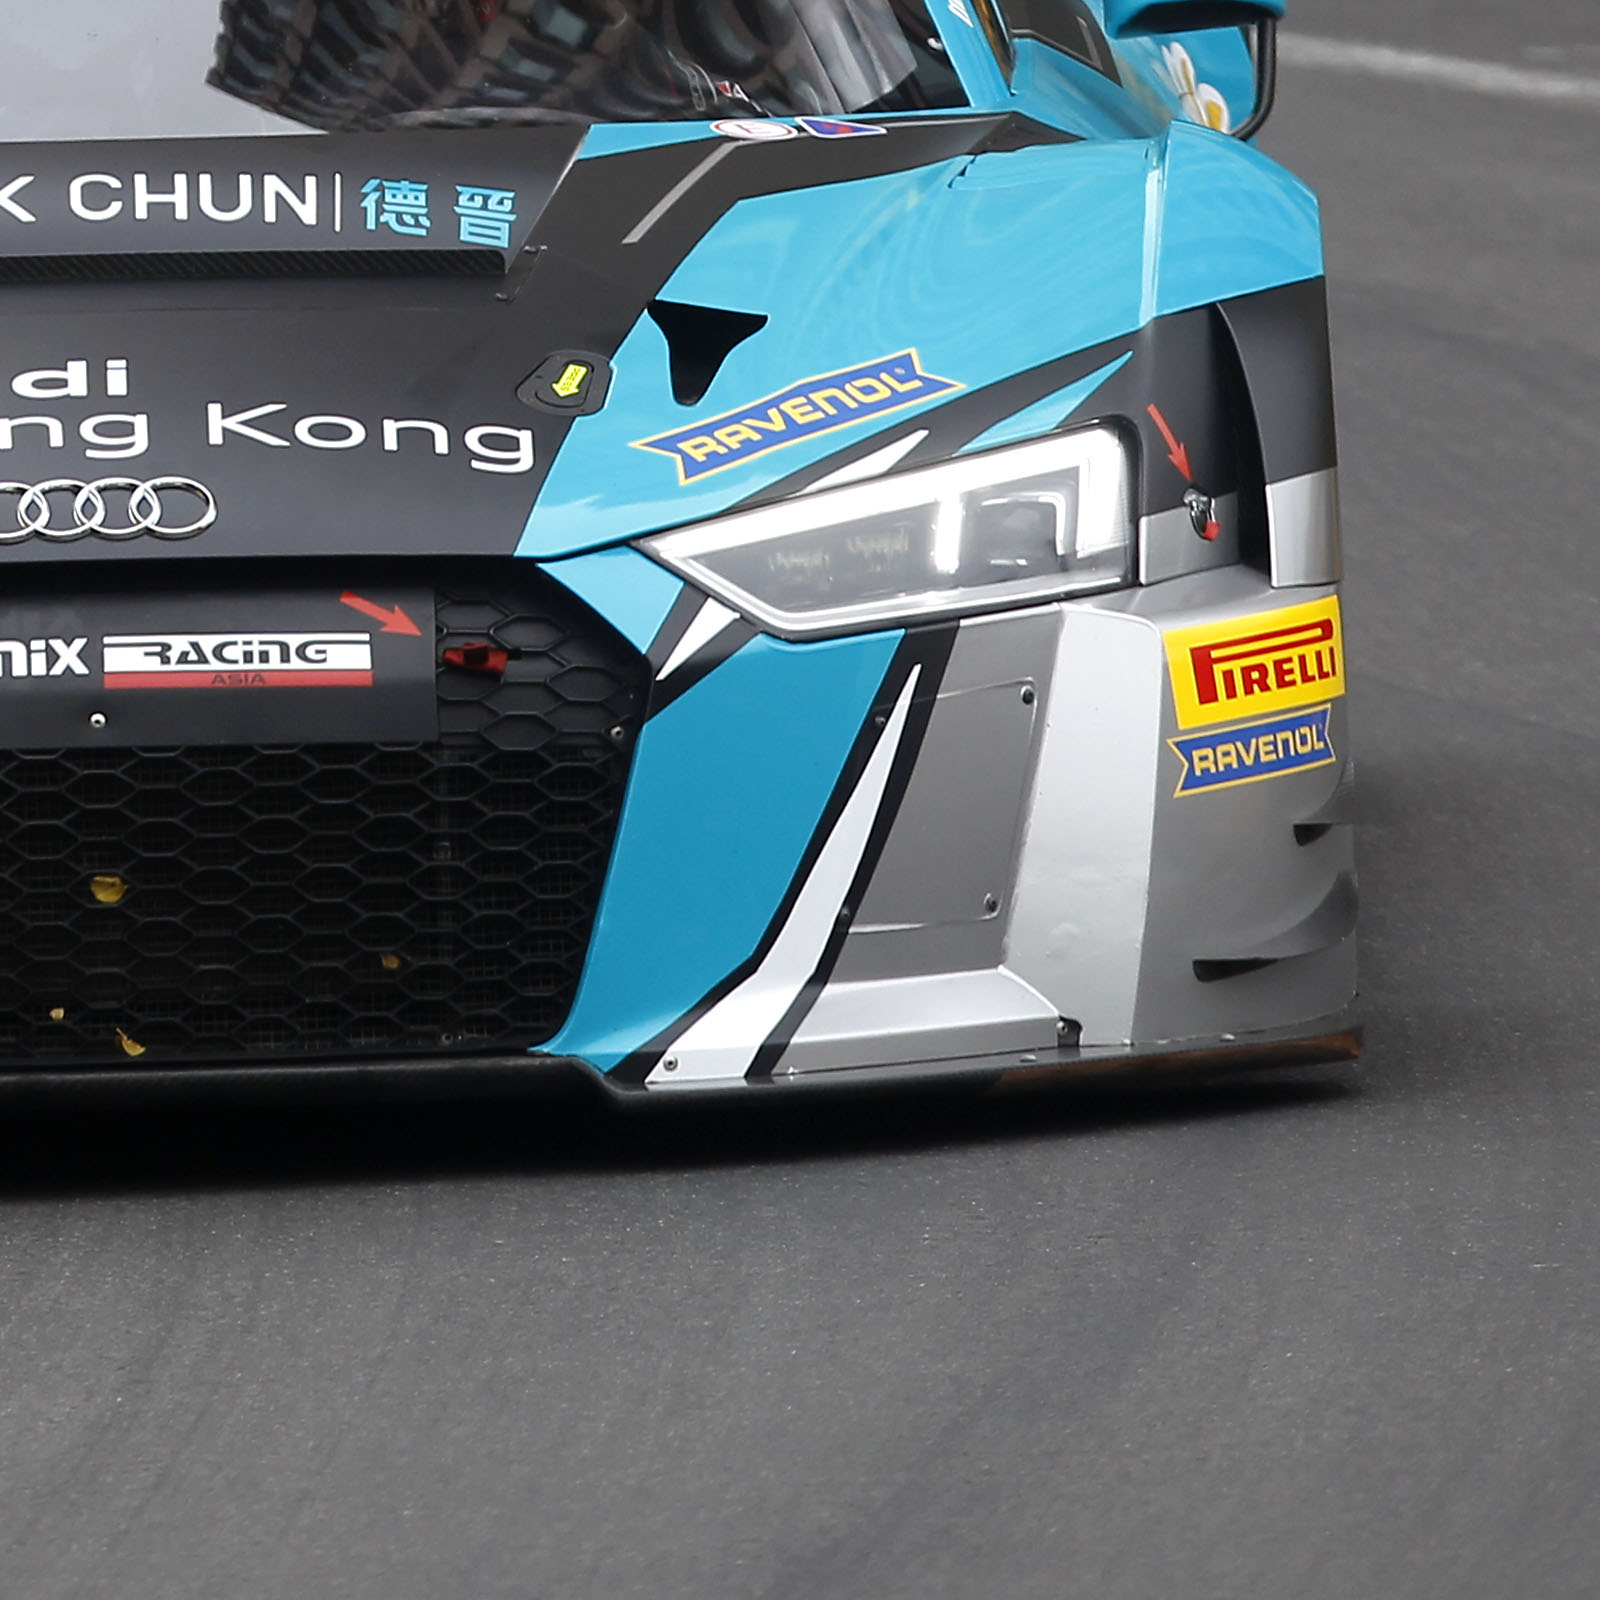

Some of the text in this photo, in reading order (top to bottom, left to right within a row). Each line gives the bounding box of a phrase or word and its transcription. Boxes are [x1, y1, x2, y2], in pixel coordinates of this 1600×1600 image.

[68, 172, 318, 227] CHUN
[359, 177, 518, 249] 德晉
[206, 401, 536, 476] Kong
[676, 371, 923, 462] RAVENOL
[210, 671, 267, 686] ASIA
[1188, 617, 1337, 706] PIRELLI
[1191, 723, 1325, 777] RAVENOL
